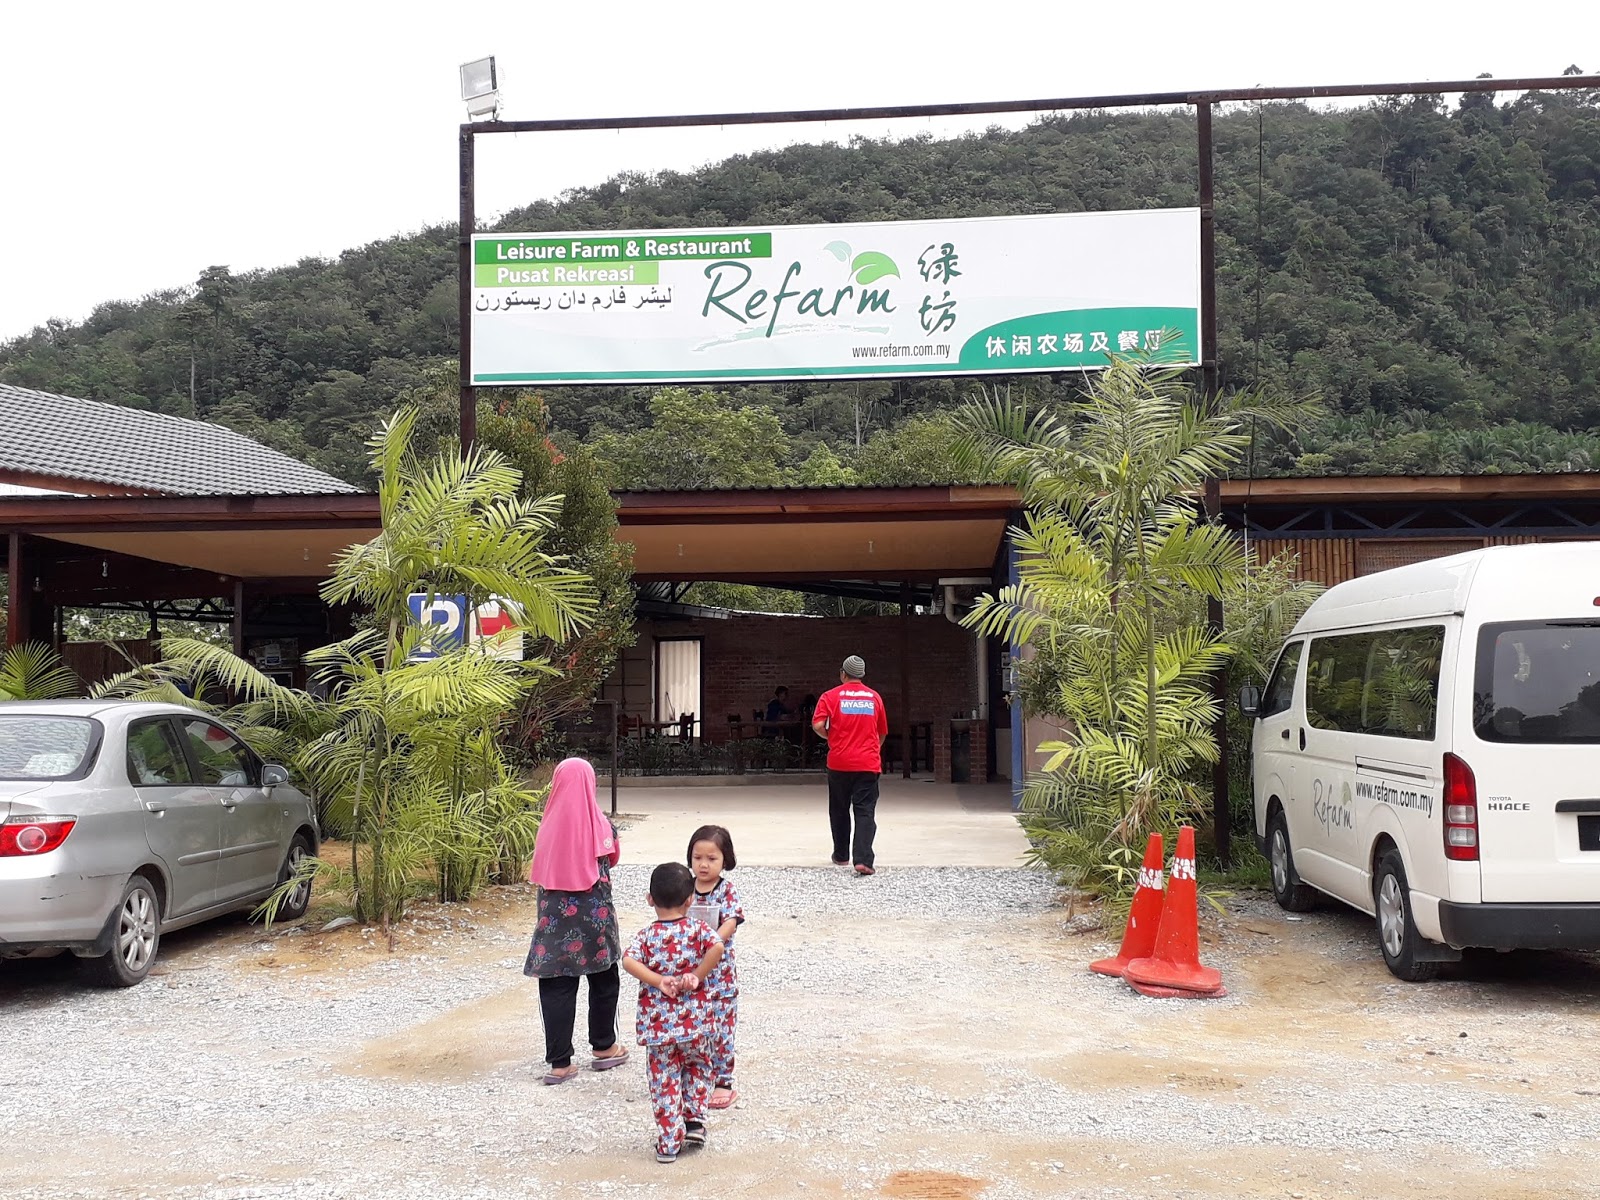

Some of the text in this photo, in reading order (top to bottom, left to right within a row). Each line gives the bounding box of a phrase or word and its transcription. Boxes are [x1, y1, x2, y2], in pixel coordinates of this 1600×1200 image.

[496, 237, 752, 261] Leisure Farm & Restaurant
[497, 264, 635, 284] Pusat Rekreasi
[475, 285, 673, 312] ليشر فارم دان ريستورن
[701, 260, 897, 338] Refarm
[852, 343, 951, 359] www.refarm.com.my
[420, 600, 461, 653] P
[1313, 778, 1353, 838] Refarm
[1356, 781, 1434, 819] www.refarm.com.my
[1488, 803, 1531, 811] HIACE
